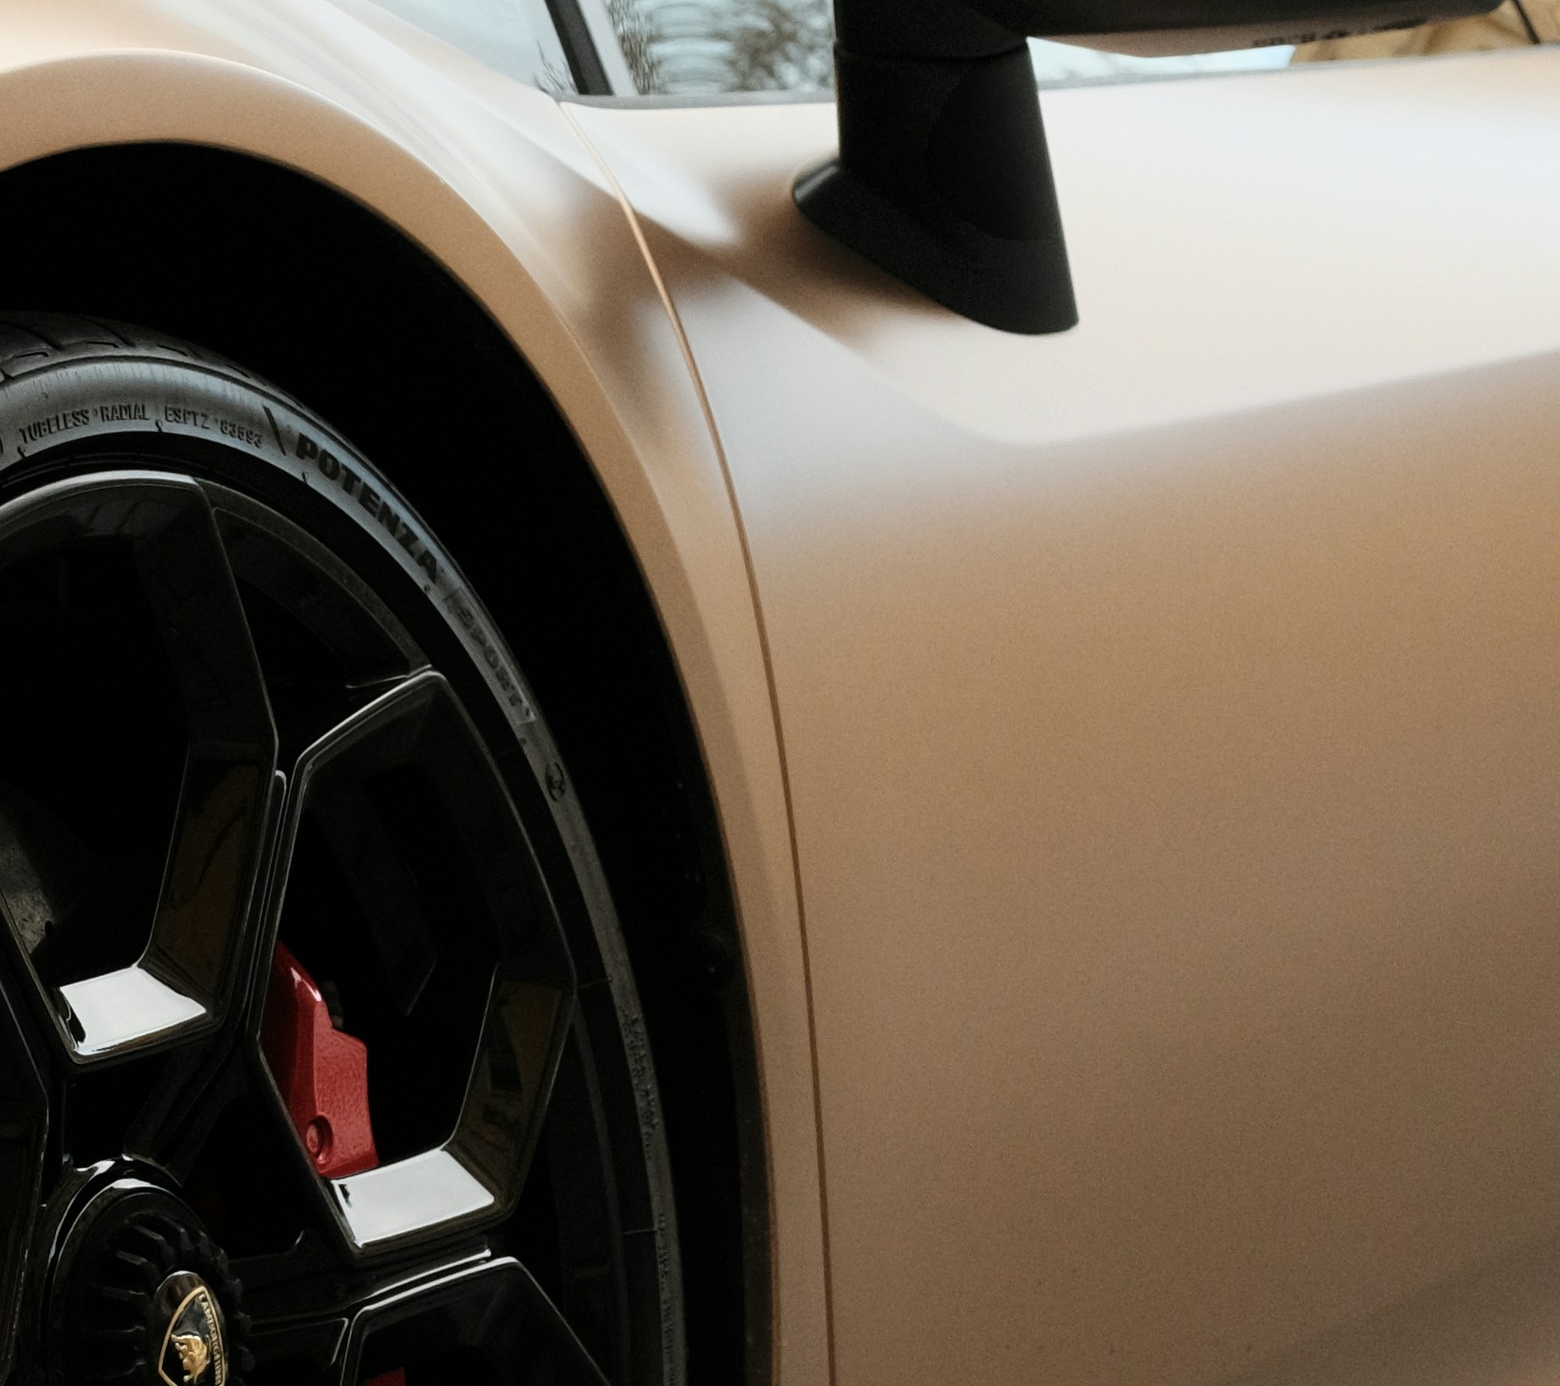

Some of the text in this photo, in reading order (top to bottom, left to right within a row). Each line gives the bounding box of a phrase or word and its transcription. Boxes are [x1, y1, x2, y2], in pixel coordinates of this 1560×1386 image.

[18, 409, 91, 444] TUBELESS
[98, 404, 151, 423] RADIAL
[295, 432, 442, 585] POTENZA
